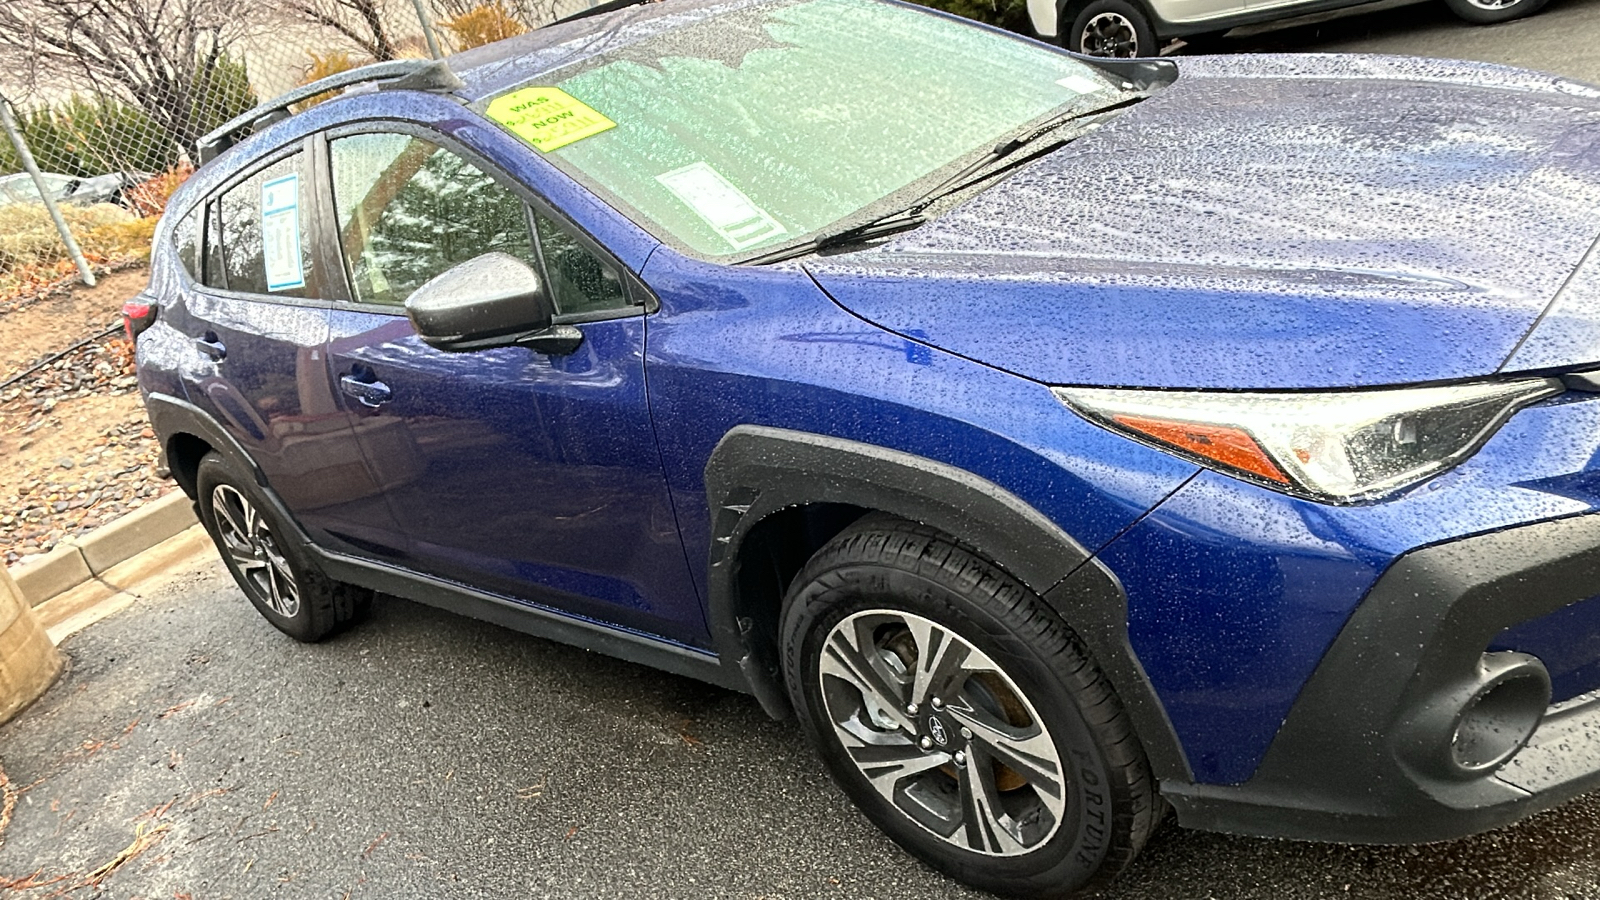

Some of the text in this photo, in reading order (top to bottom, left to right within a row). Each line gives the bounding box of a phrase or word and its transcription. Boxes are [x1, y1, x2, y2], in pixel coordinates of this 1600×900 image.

[509, 96, 549, 113] WAS
[532, 110, 574, 129] NOW
[1072, 749, 1105, 869] FORTUNE
